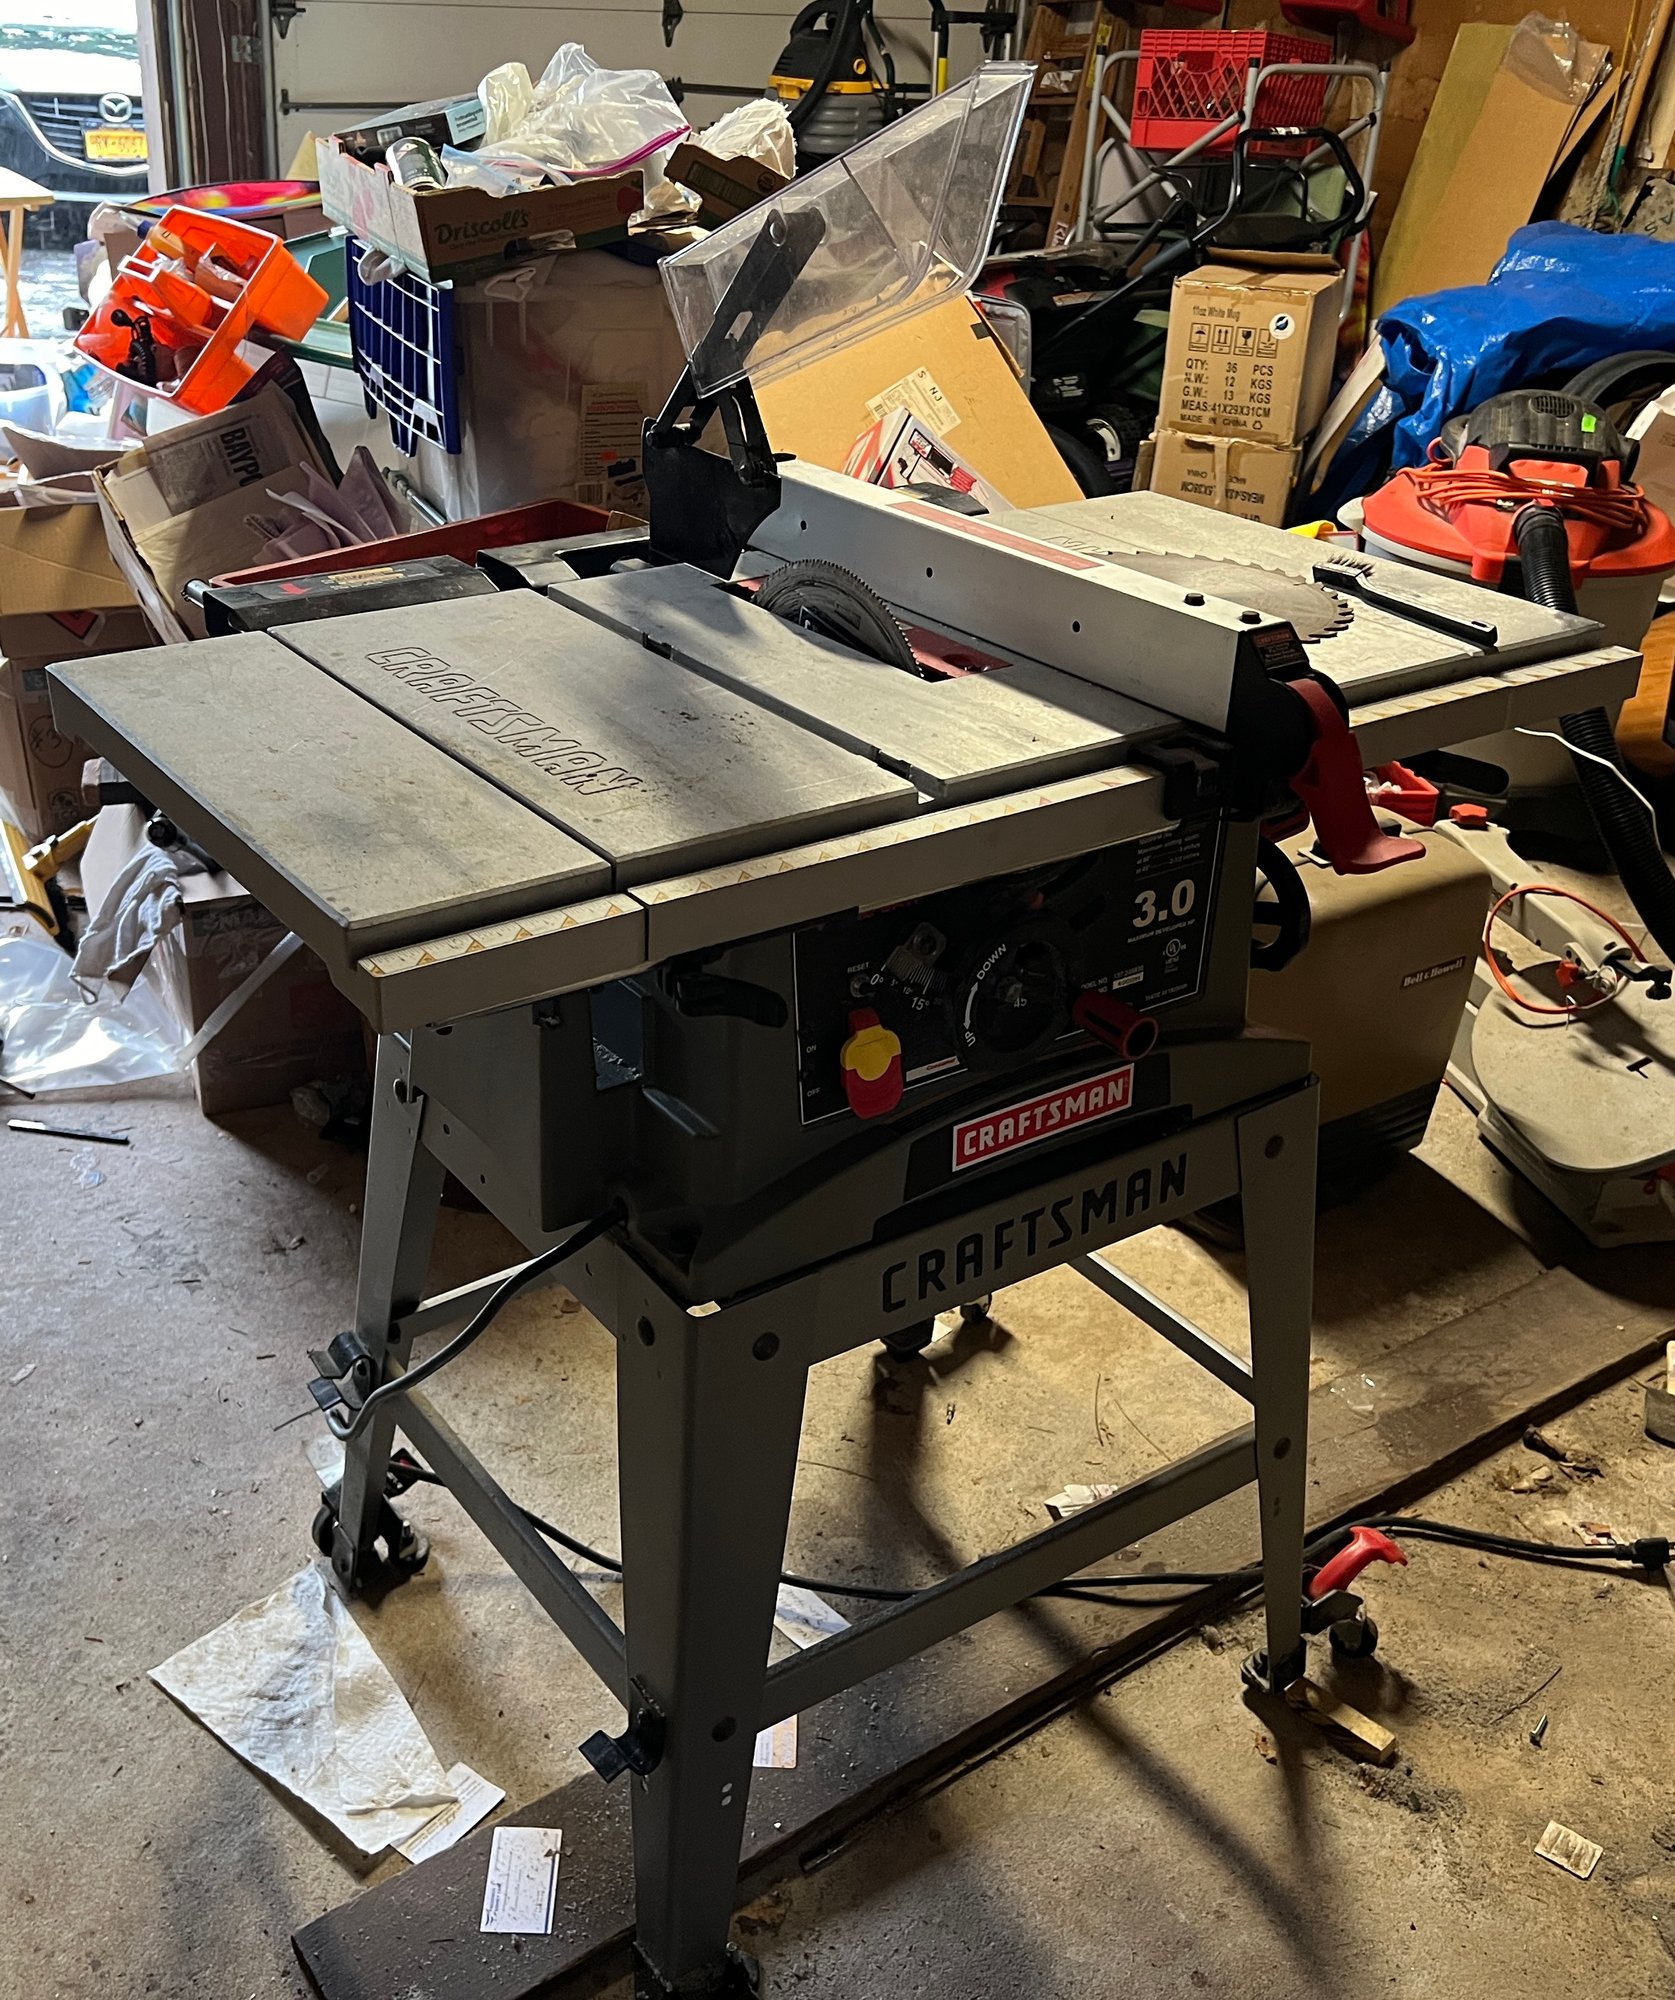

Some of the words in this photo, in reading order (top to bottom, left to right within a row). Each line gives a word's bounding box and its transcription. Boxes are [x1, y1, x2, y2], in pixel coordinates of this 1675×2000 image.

[434, 207, 530, 245] Driscoll's
[1193, 306, 1206, 317] 11oz
[1208, 307, 1225, 318] White
[1227, 308, 1240, 322] Mug
[918, 370, 926, 378] S
[1186, 358, 1208, 371] QTY:
[1226, 362, 1238, 374] 36
[1253, 364, 1274, 376] PCS
[1225, 376, 1235, 387] 12
[1250, 378, 1272, 390] KGS
[1183, 385, 1208, 398] G.W.:
[1224, 390, 1234, 401] 13
[1249, 392, 1271, 404] KGS
[1180, 413, 1202, 423] MADE
[1208, 416, 1217, 425] IN
[1222, 418, 1247, 428] CHINA
[365, 646, 644, 795] CRAFTSMAN
[1132, 879, 1195, 928] 3.0
[847, 961, 870, 973] RESET
[976, 943, 1007, 980] DOWN
[964, 1031, 976, 1047] UP
[806, 1044, 817, 1053] ON
[807, 1087, 820, 1097] OFF
[963, 1077, 1125, 1156] CRAFTSMAN
[882, 1152, 1188, 1313] CRAFTSMAN
